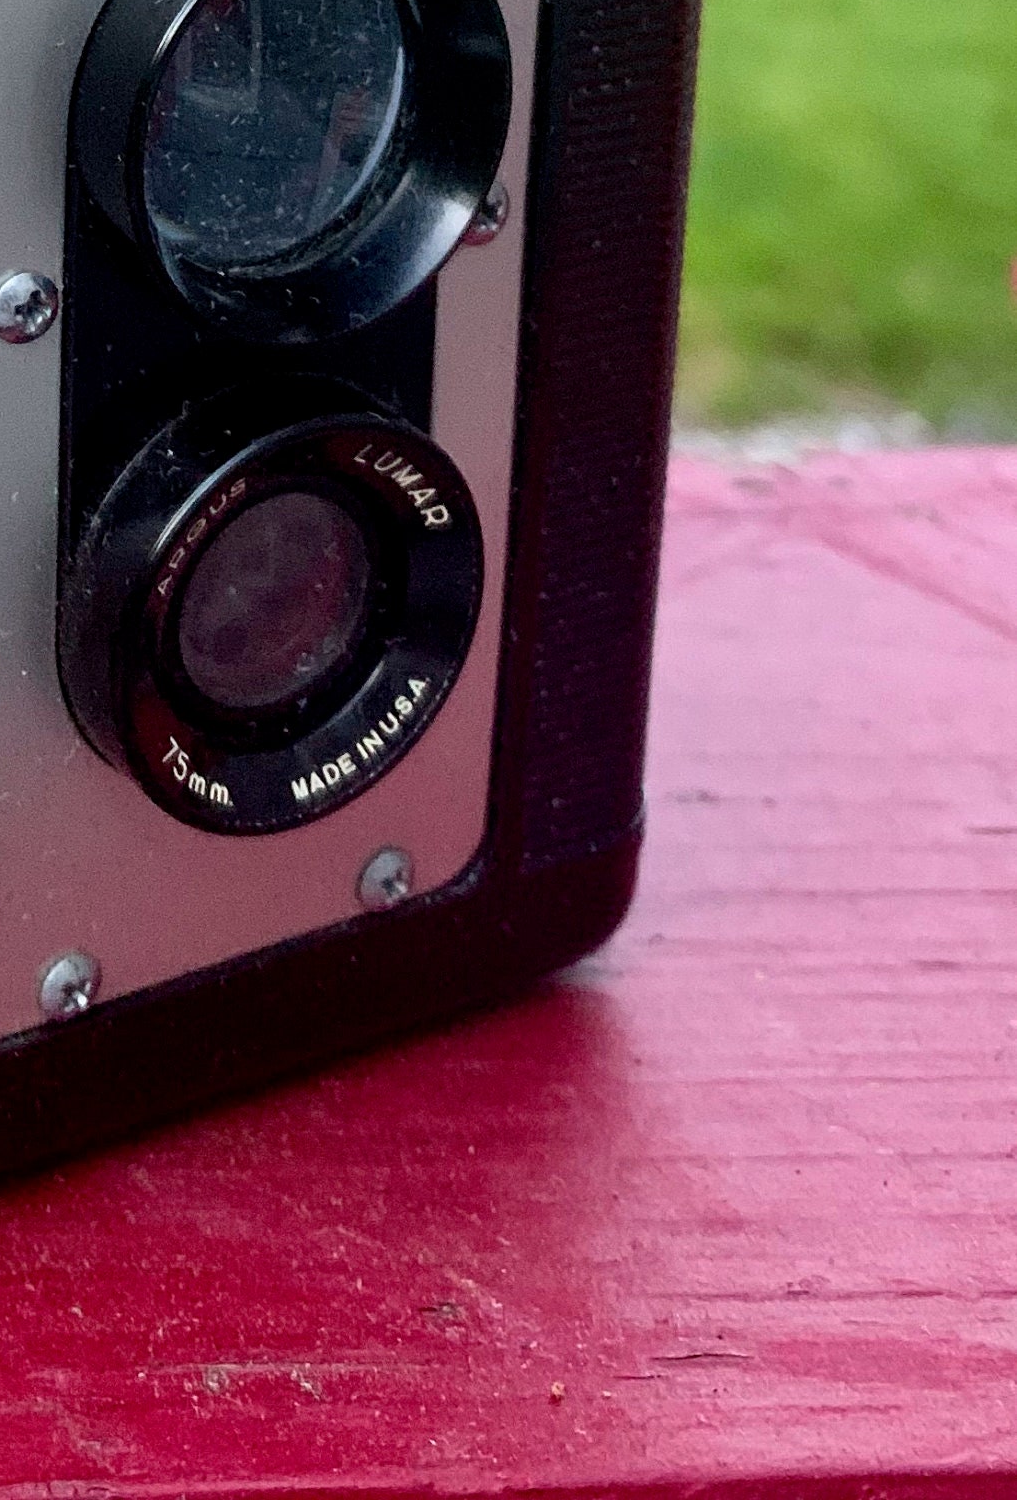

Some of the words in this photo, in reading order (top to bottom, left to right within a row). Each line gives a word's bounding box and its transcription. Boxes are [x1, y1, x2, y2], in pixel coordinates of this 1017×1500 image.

[353, 443, 451, 530] LUMAR
[290, 752, 357, 801] MADE
[355, 728, 385, 760] IN
